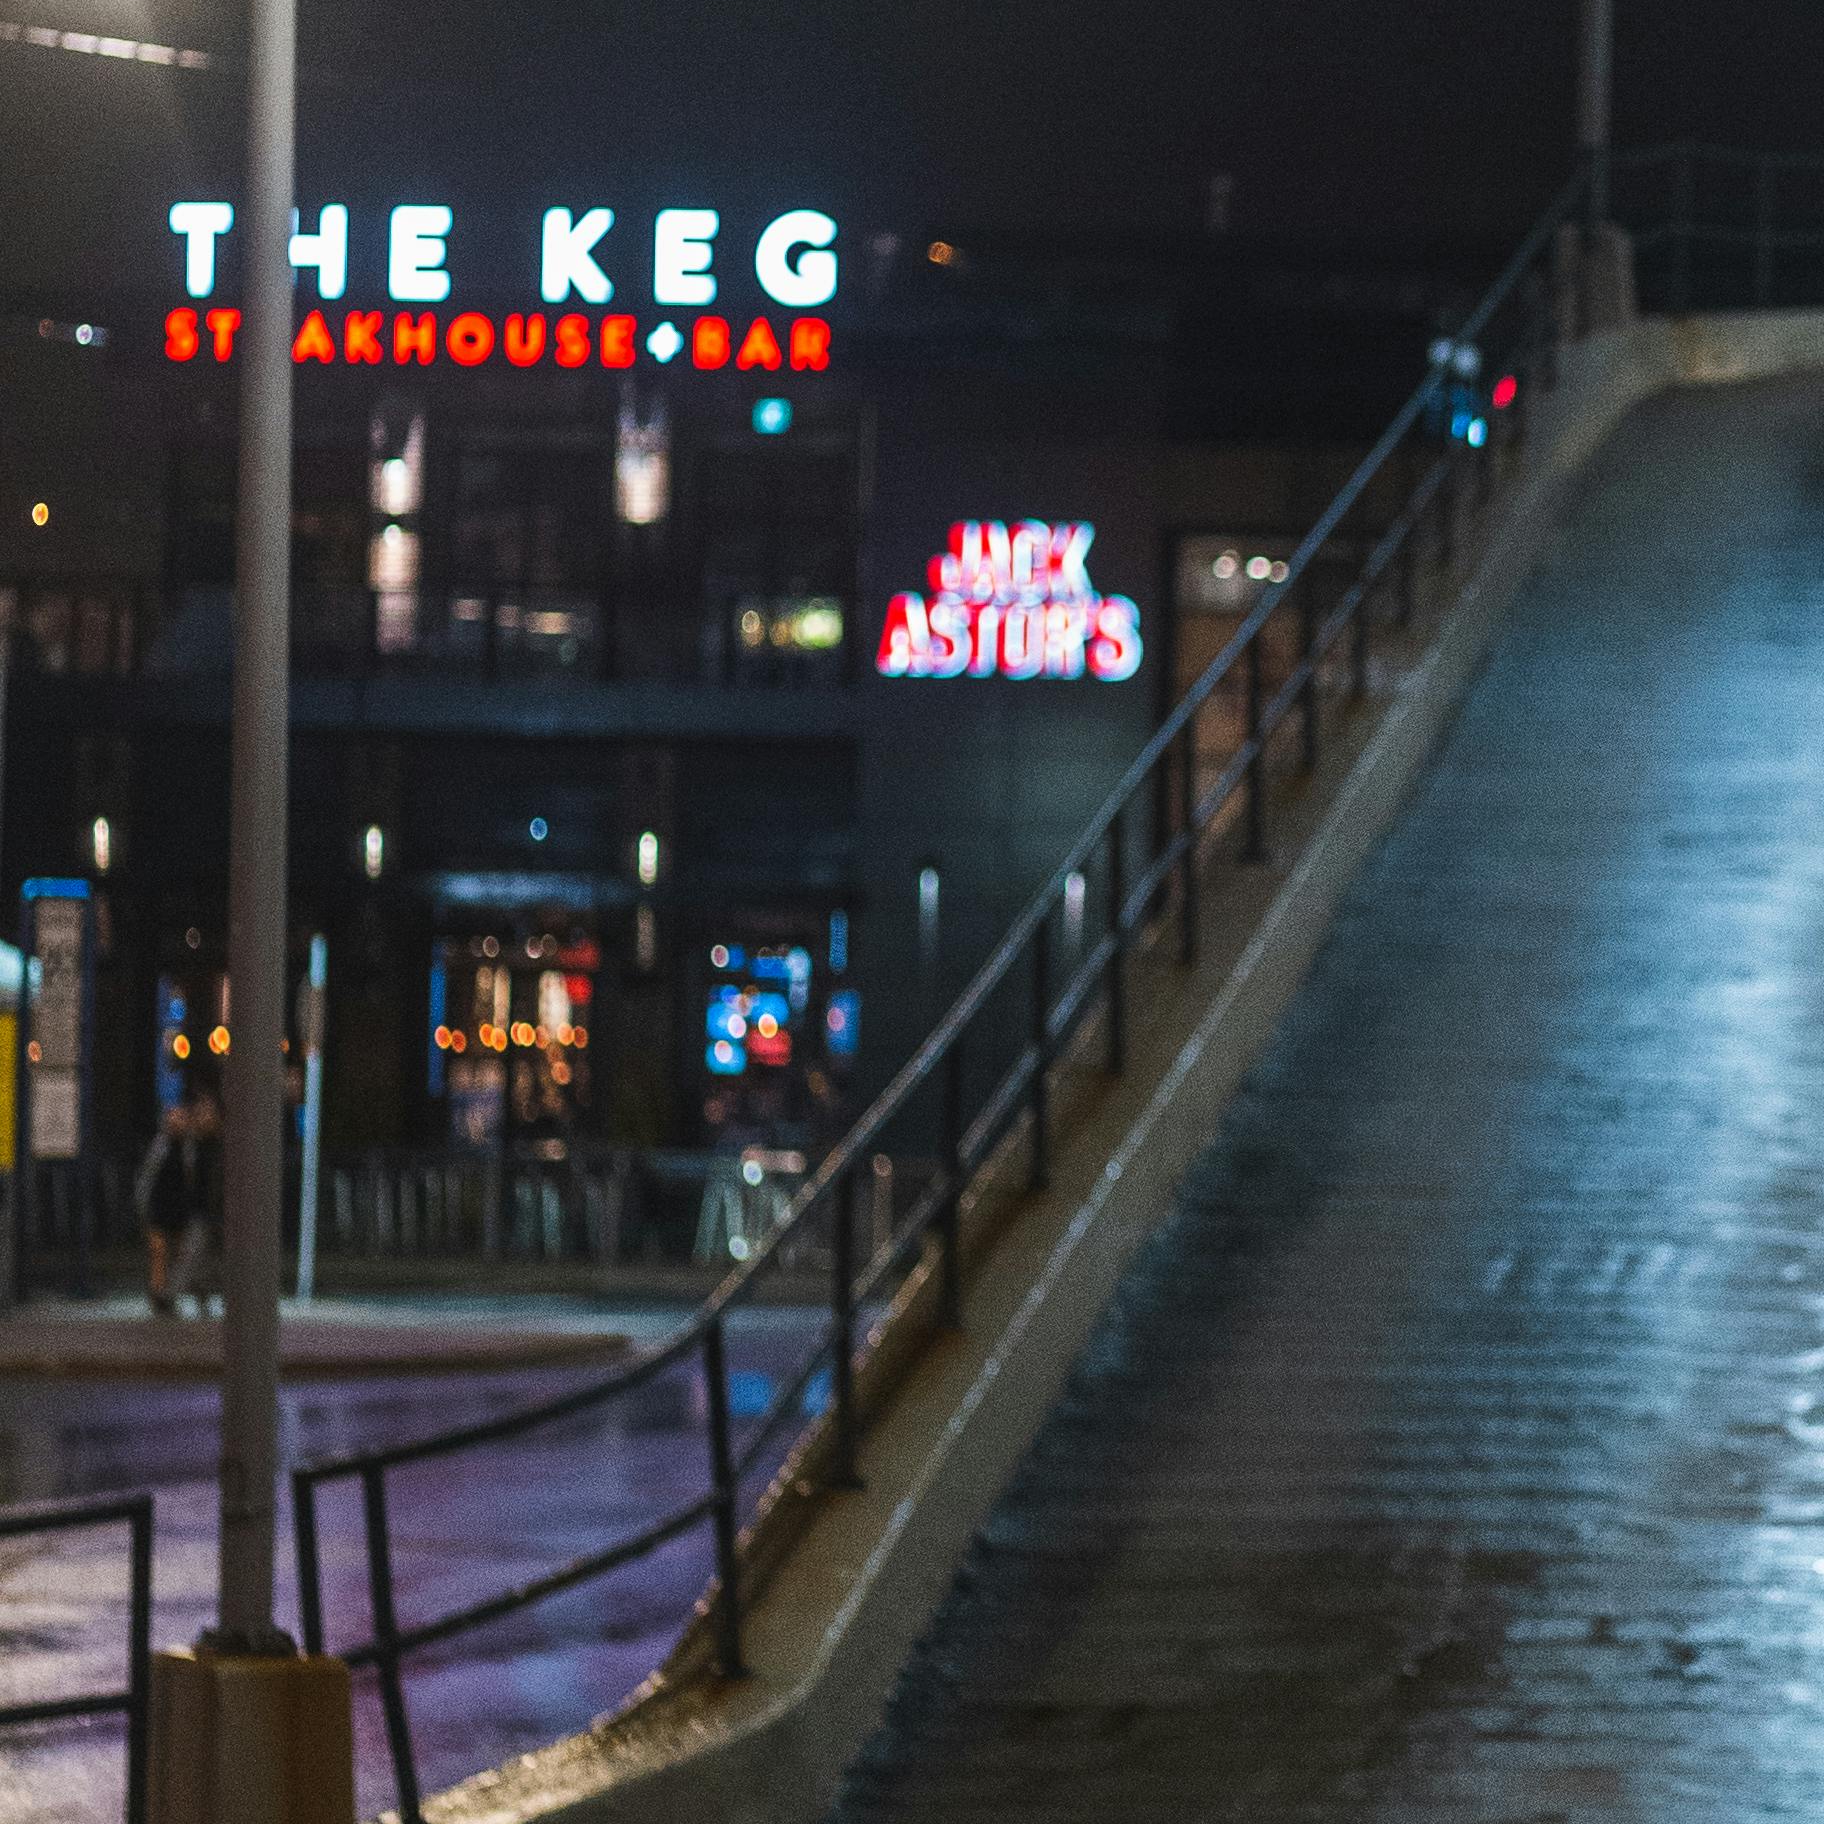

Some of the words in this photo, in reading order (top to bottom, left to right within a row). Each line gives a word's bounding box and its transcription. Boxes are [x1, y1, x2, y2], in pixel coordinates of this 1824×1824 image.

[168, 202, 454, 302] THE
[541, 206, 838, 307] KEG
[165, 308, 637, 369] STAKHOUSE
[692, 315, 831, 371] BAR
[927, 518, 1095, 608] JACK
[876, 592, 1143, 682] ASTOR'S
